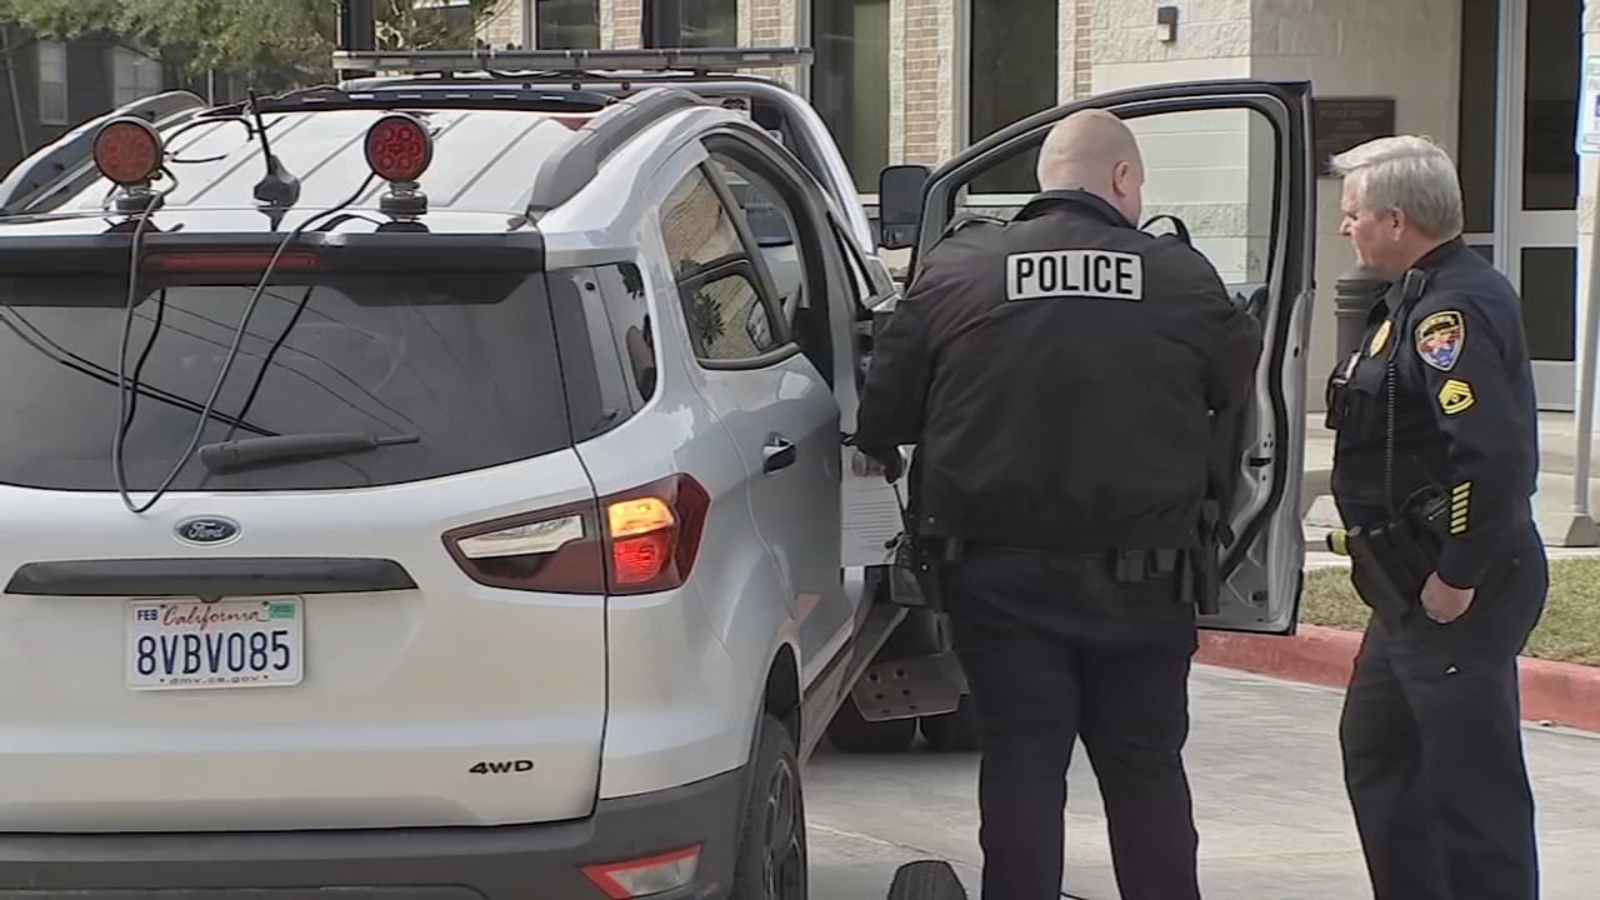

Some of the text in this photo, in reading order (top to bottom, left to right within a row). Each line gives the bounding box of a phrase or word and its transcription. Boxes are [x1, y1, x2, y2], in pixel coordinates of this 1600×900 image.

[1016, 255, 1133, 295] POLICE
[137, 609, 158, 621] FEB
[163, 605, 271, 630] California
[138, 630, 290, 675] 8VBV085
[468, 760, 534, 774] 4WD
